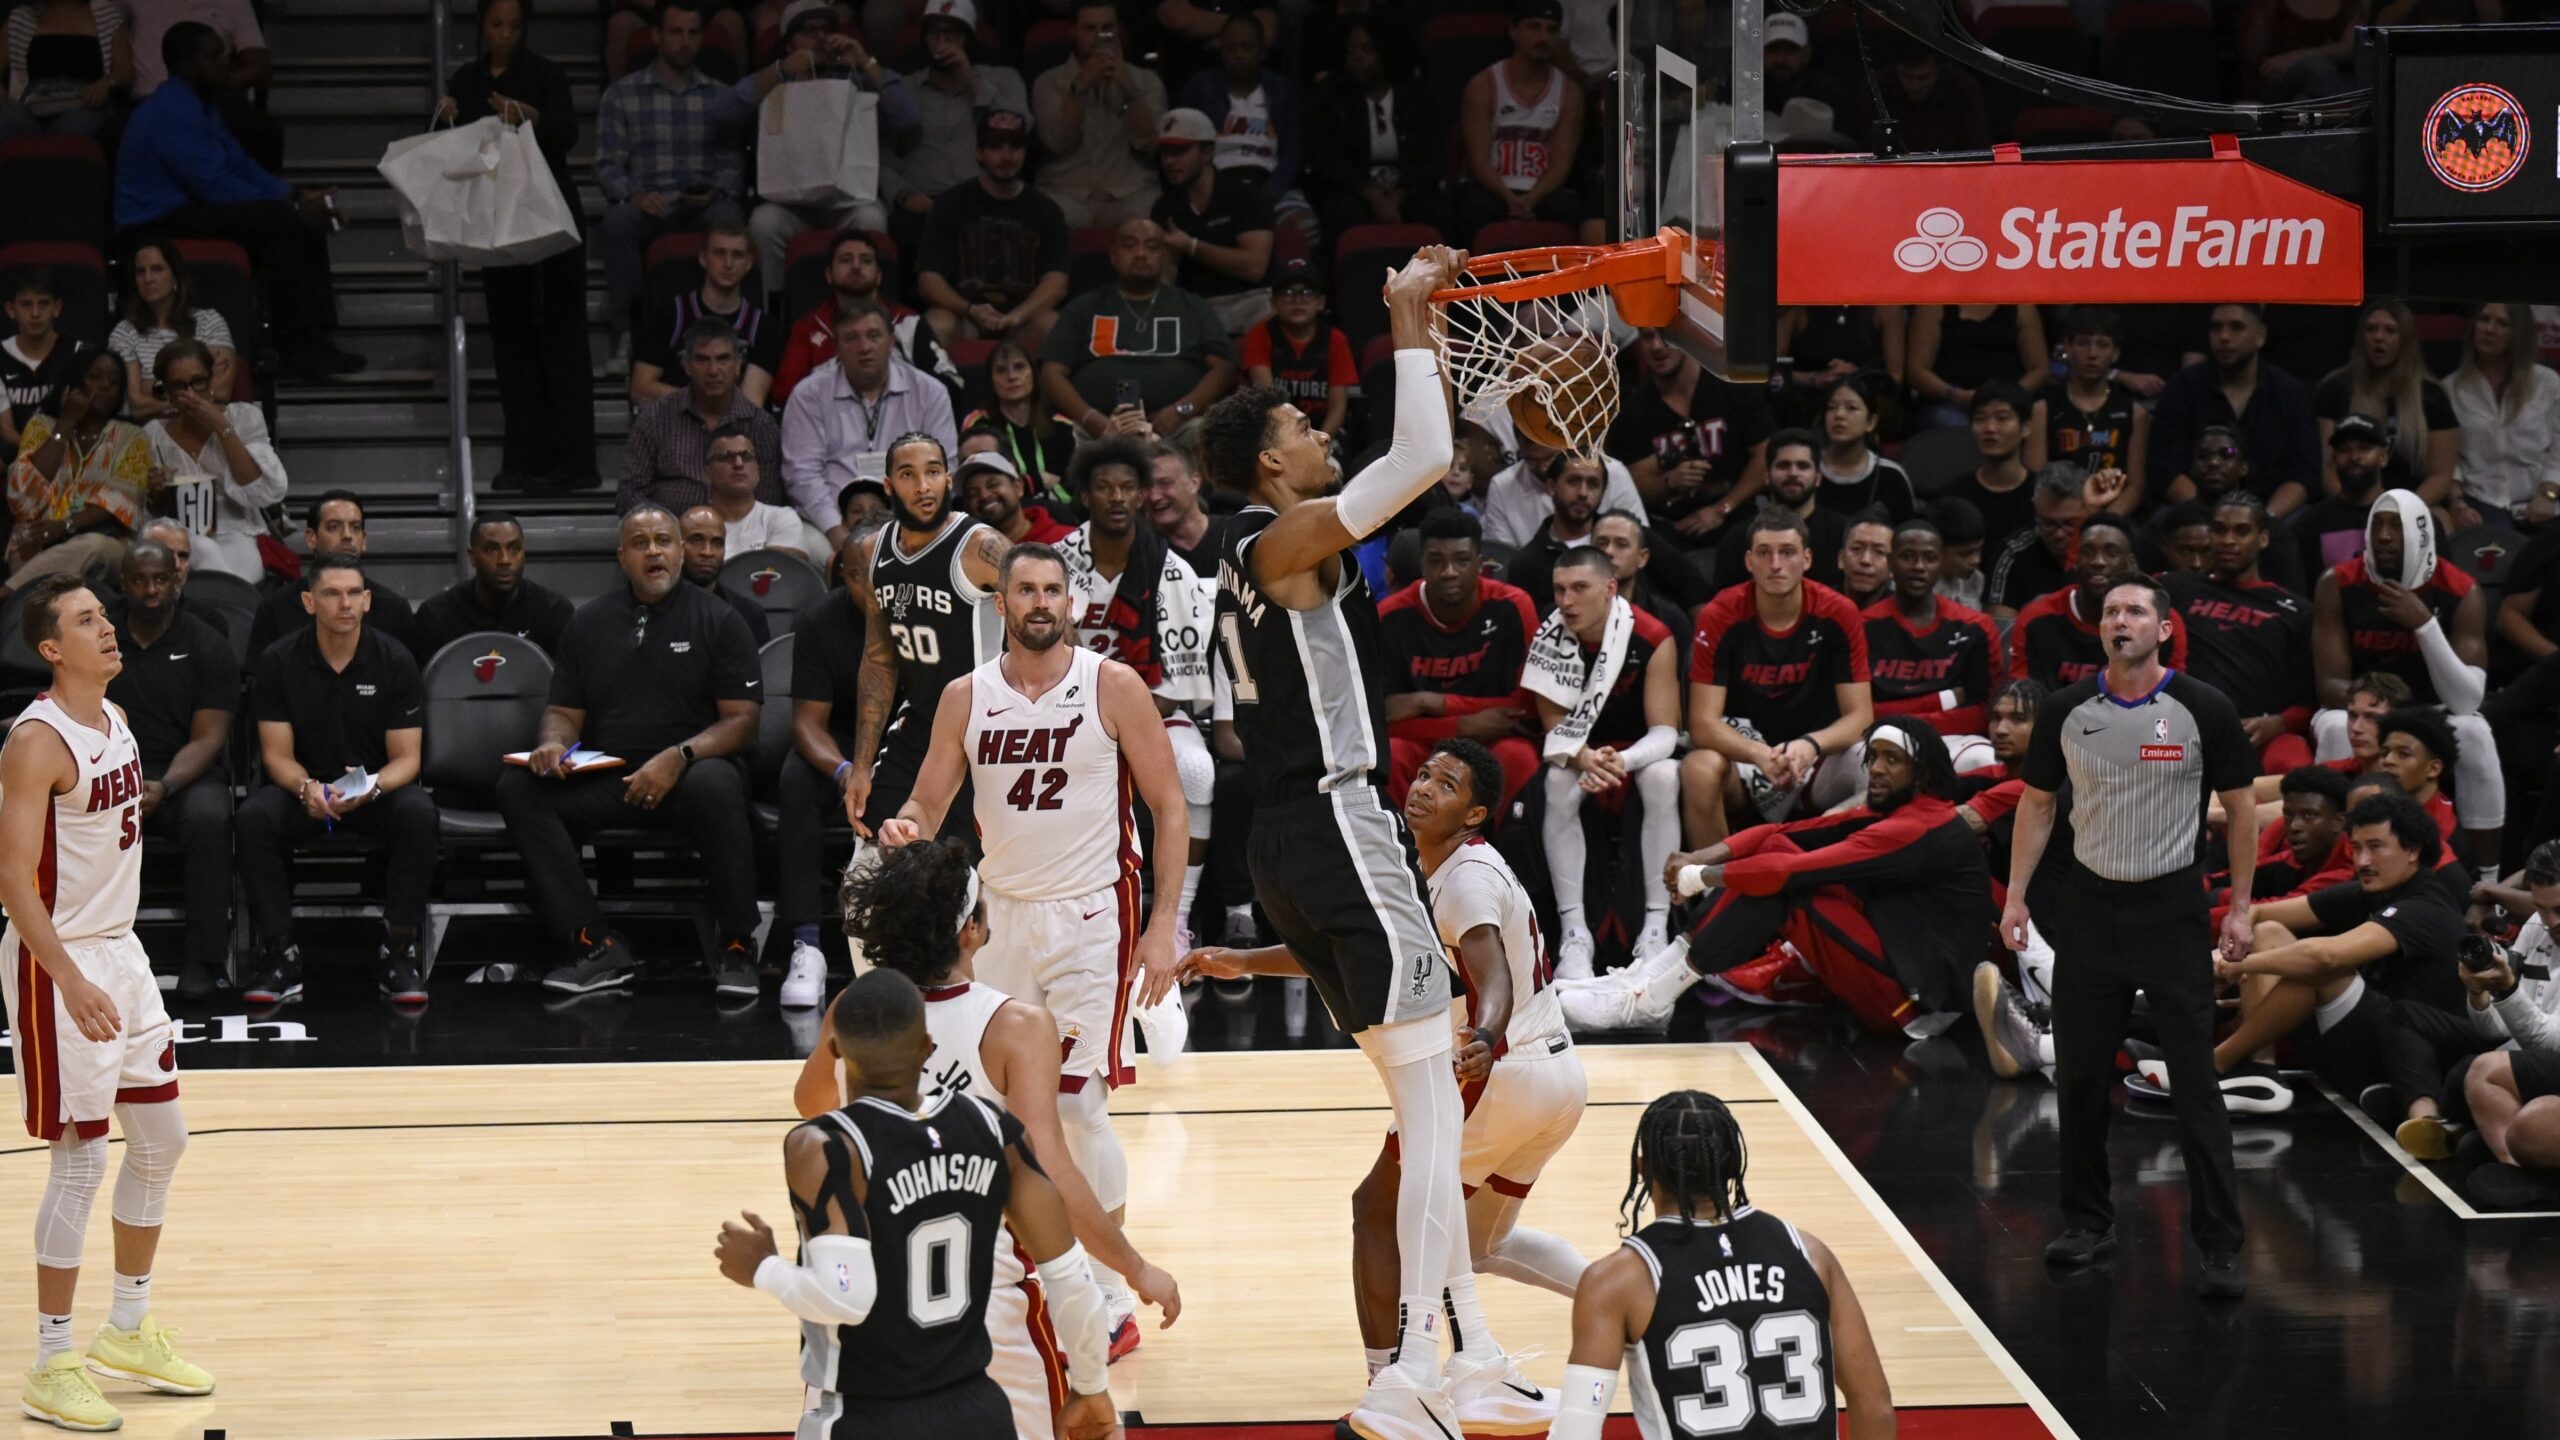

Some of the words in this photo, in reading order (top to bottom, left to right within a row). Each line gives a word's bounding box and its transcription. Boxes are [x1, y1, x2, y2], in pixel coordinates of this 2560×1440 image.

[1499, 139, 1549, 178] 13
[2187, 598, 2280, 628] HEAT
[890, 623, 942, 665] 30
[1218, 611, 1260, 705] 1
[1410, 640, 1491, 678] HEAT
[1873, 651, 1960, 680] HEAT
[1742, 652, 1816, 687] HEAT
[977, 713, 1084, 766] HEAT
[2141, 747, 2182, 758] Emirates
[86, 751, 142, 813] HEAT
[1006, 768, 1069, 812] 42
[119, 804, 143, 852] 5
[887, 1153, 998, 1215] JOHNSON
[906, 1211, 973, 1330] 0
[1694, 1262, 1786, 1313] JONES
[1664, 1308, 1828, 1438] 33
